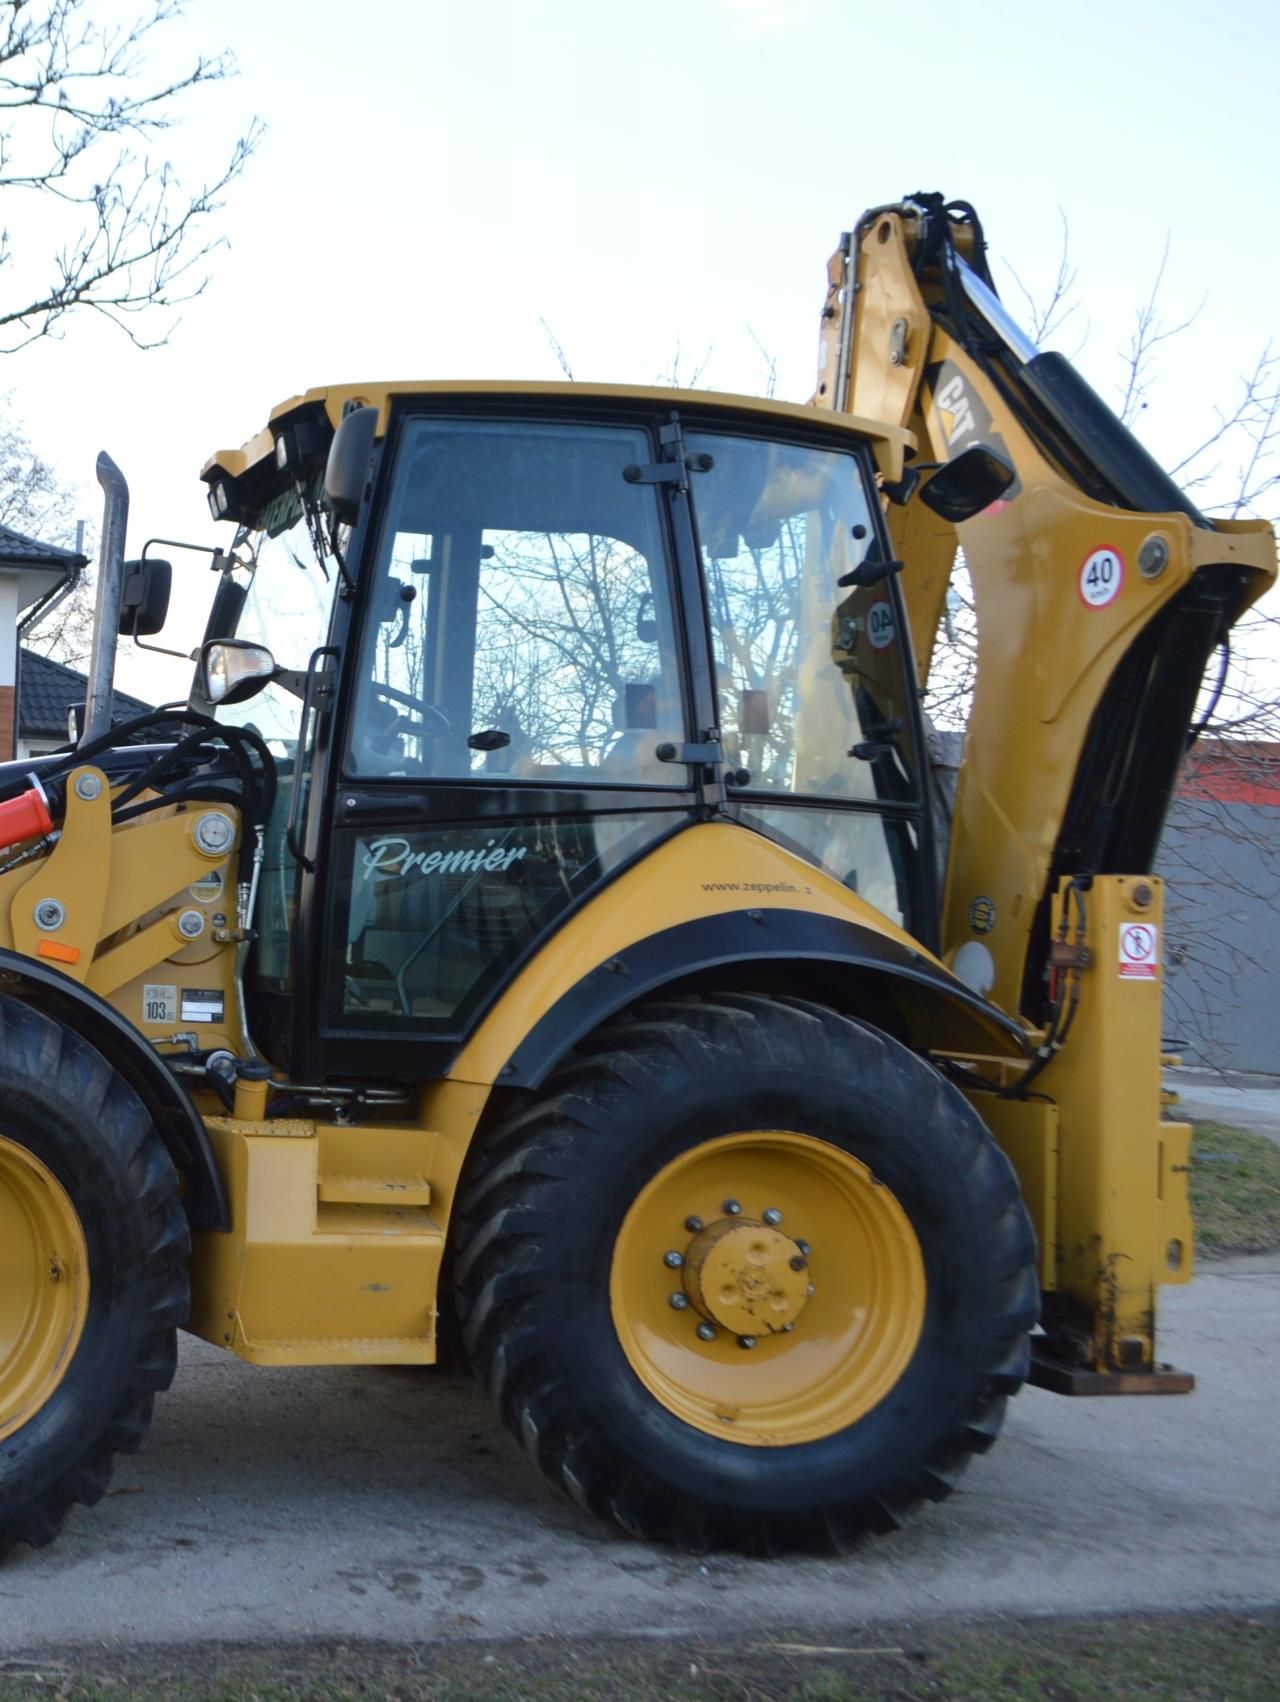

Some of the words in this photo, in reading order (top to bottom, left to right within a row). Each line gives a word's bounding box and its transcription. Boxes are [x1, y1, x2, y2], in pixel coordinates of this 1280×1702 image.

[937, 375, 976, 446] CAT
[1086, 557, 1113, 587] 40
[363, 838, 528, 880] Premier
[146, 1001, 166, 1020] 103
